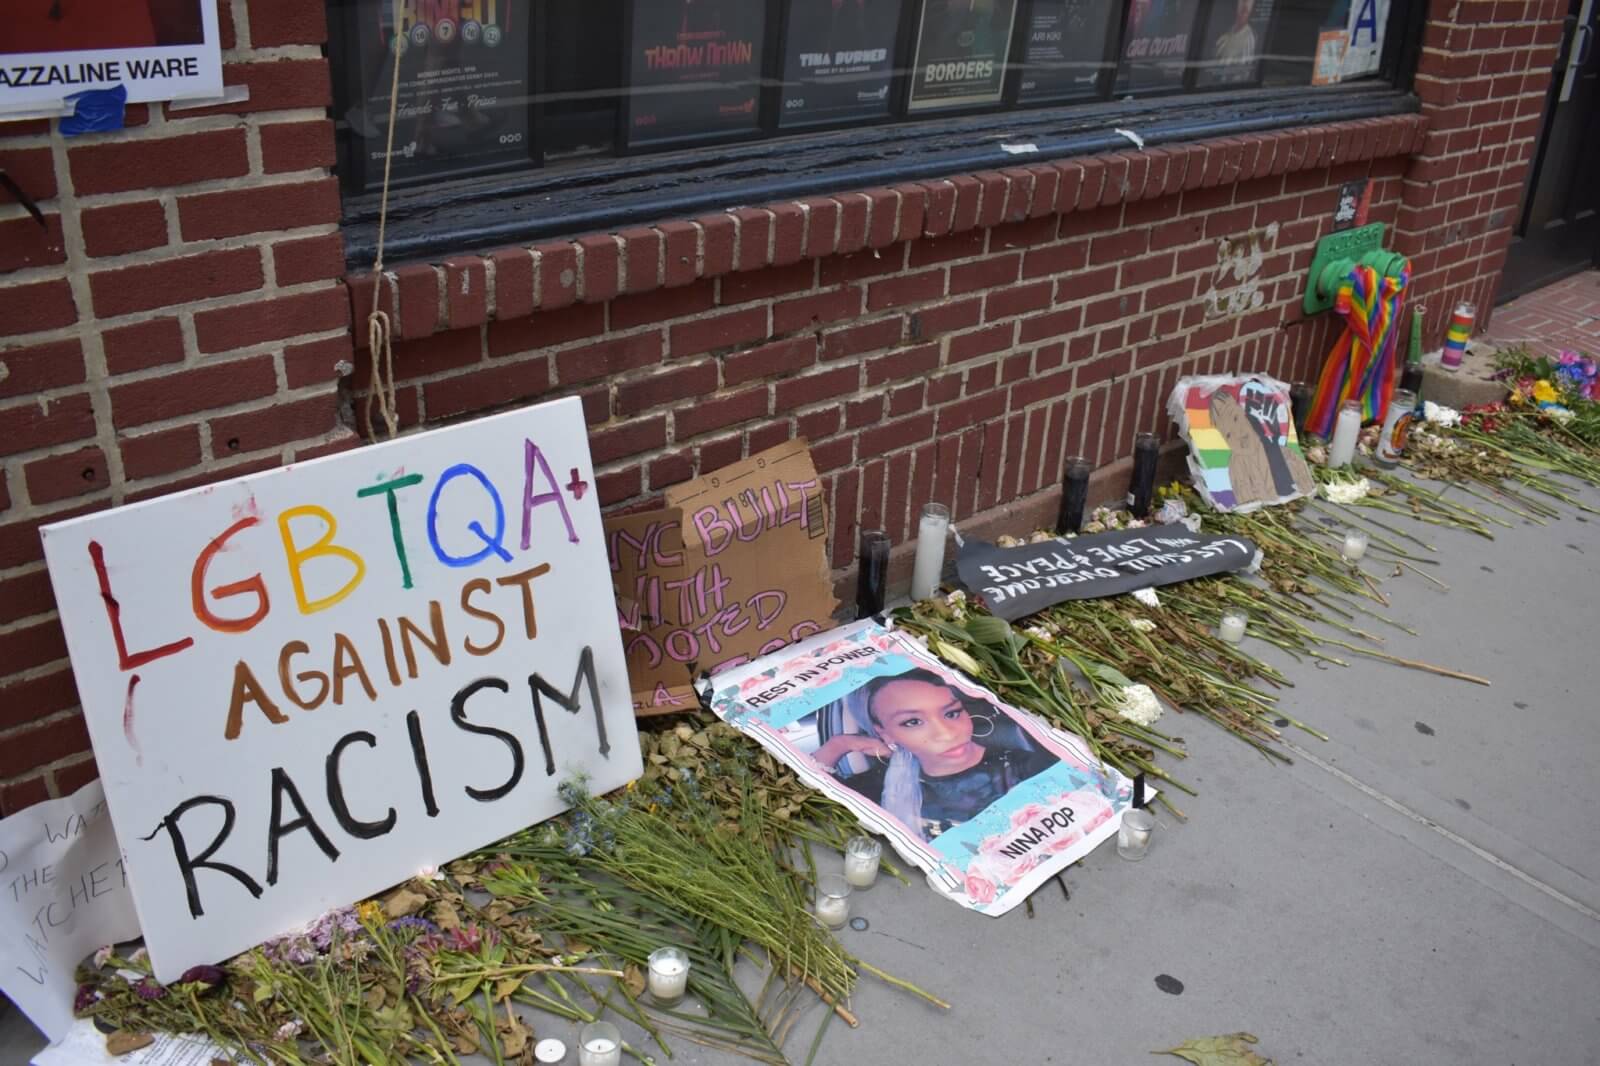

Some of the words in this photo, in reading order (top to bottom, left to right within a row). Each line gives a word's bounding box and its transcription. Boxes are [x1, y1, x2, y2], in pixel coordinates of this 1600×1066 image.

[0, 61, 121, 88] AZZALINE
[125, 57, 199, 80] WARE
[799, 52, 831, 67] TINA
[924, 60, 993, 83] BORDERS
[692, 479, 817, 557] BUILT
[88, 438, 588, 671] LGBTQA+
[980, 552, 1077, 583] PEACE
[1086, 538, 1161, 563] LOVE
[982, 565, 1121, 603] OVERCOME
[225, 563, 550, 740] AGAINST
[746, 679, 797, 708] REST
[795, 669, 820, 682] IN
[816, 645, 880, 671] POWER
[137, 646, 610, 920] RACISM
[999, 826, 1049, 860] NINA
[1040, 806, 1075, 835] POP
[9, 865, 57, 902] THE
